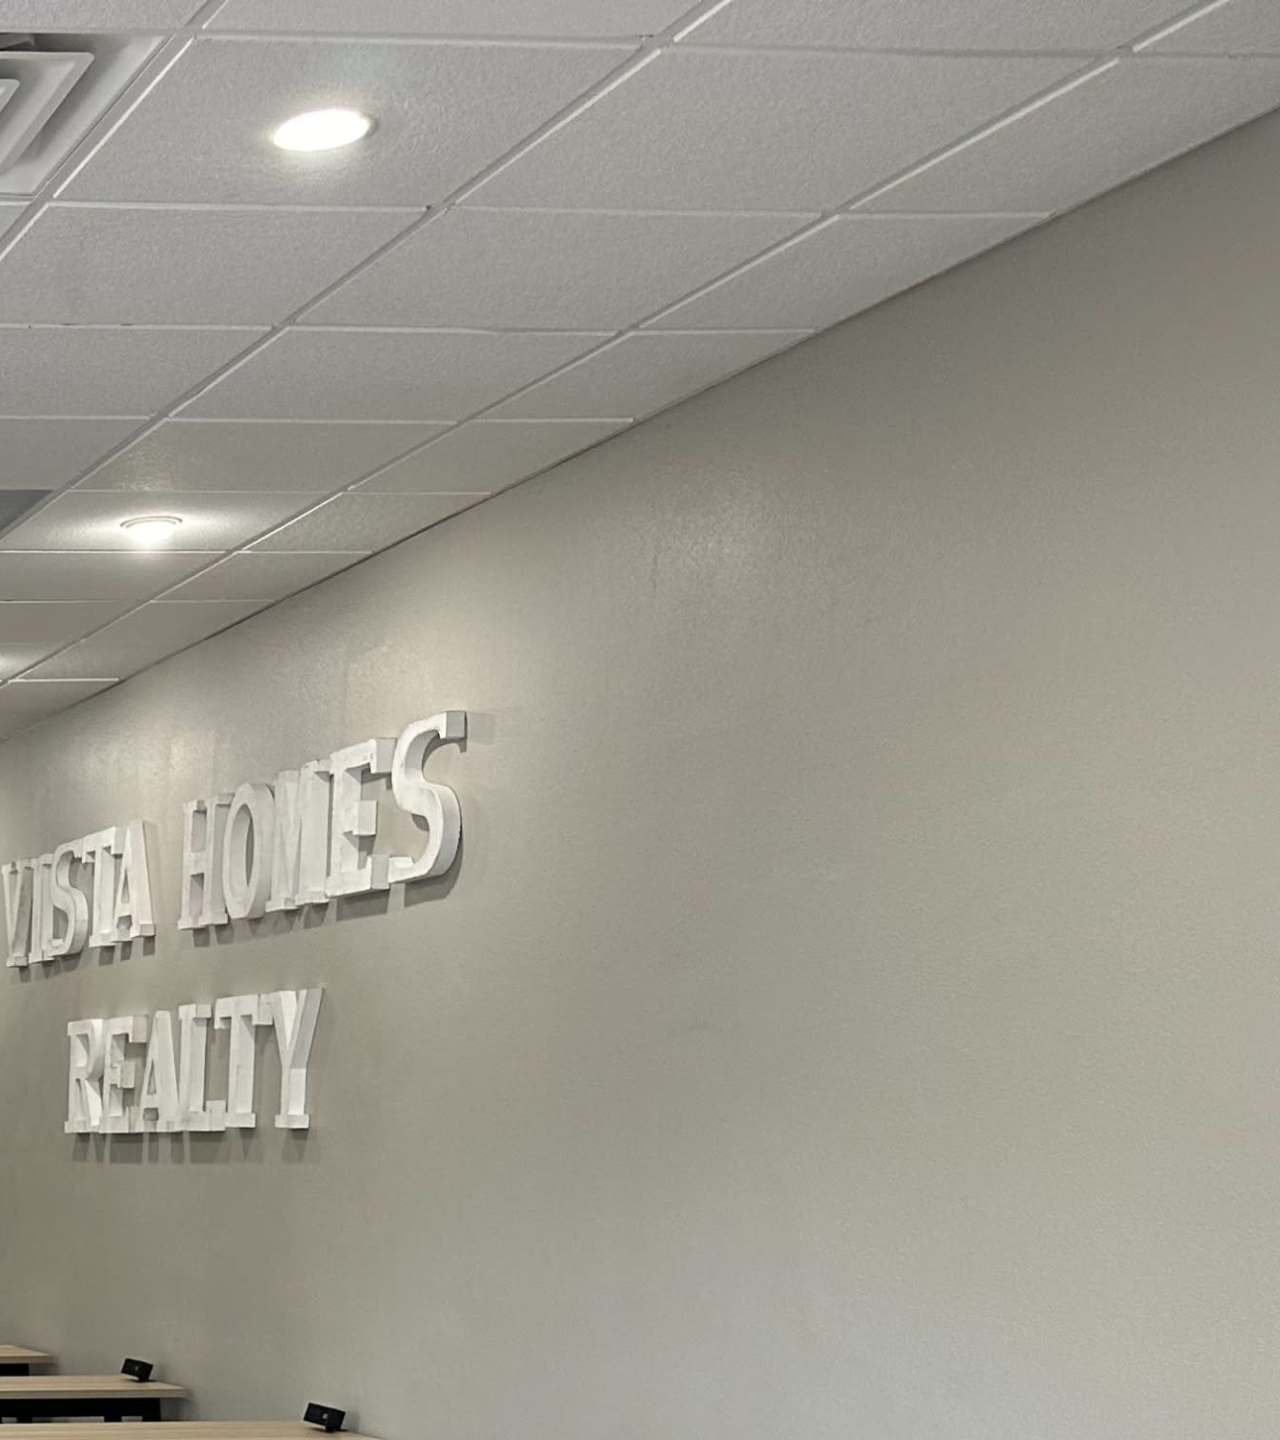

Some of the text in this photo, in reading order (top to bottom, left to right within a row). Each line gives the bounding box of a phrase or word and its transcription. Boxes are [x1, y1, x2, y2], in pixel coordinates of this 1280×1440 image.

[1, 710, 468, 968] VISTA HOMES
[64, 987, 326, 1134] REALTY
